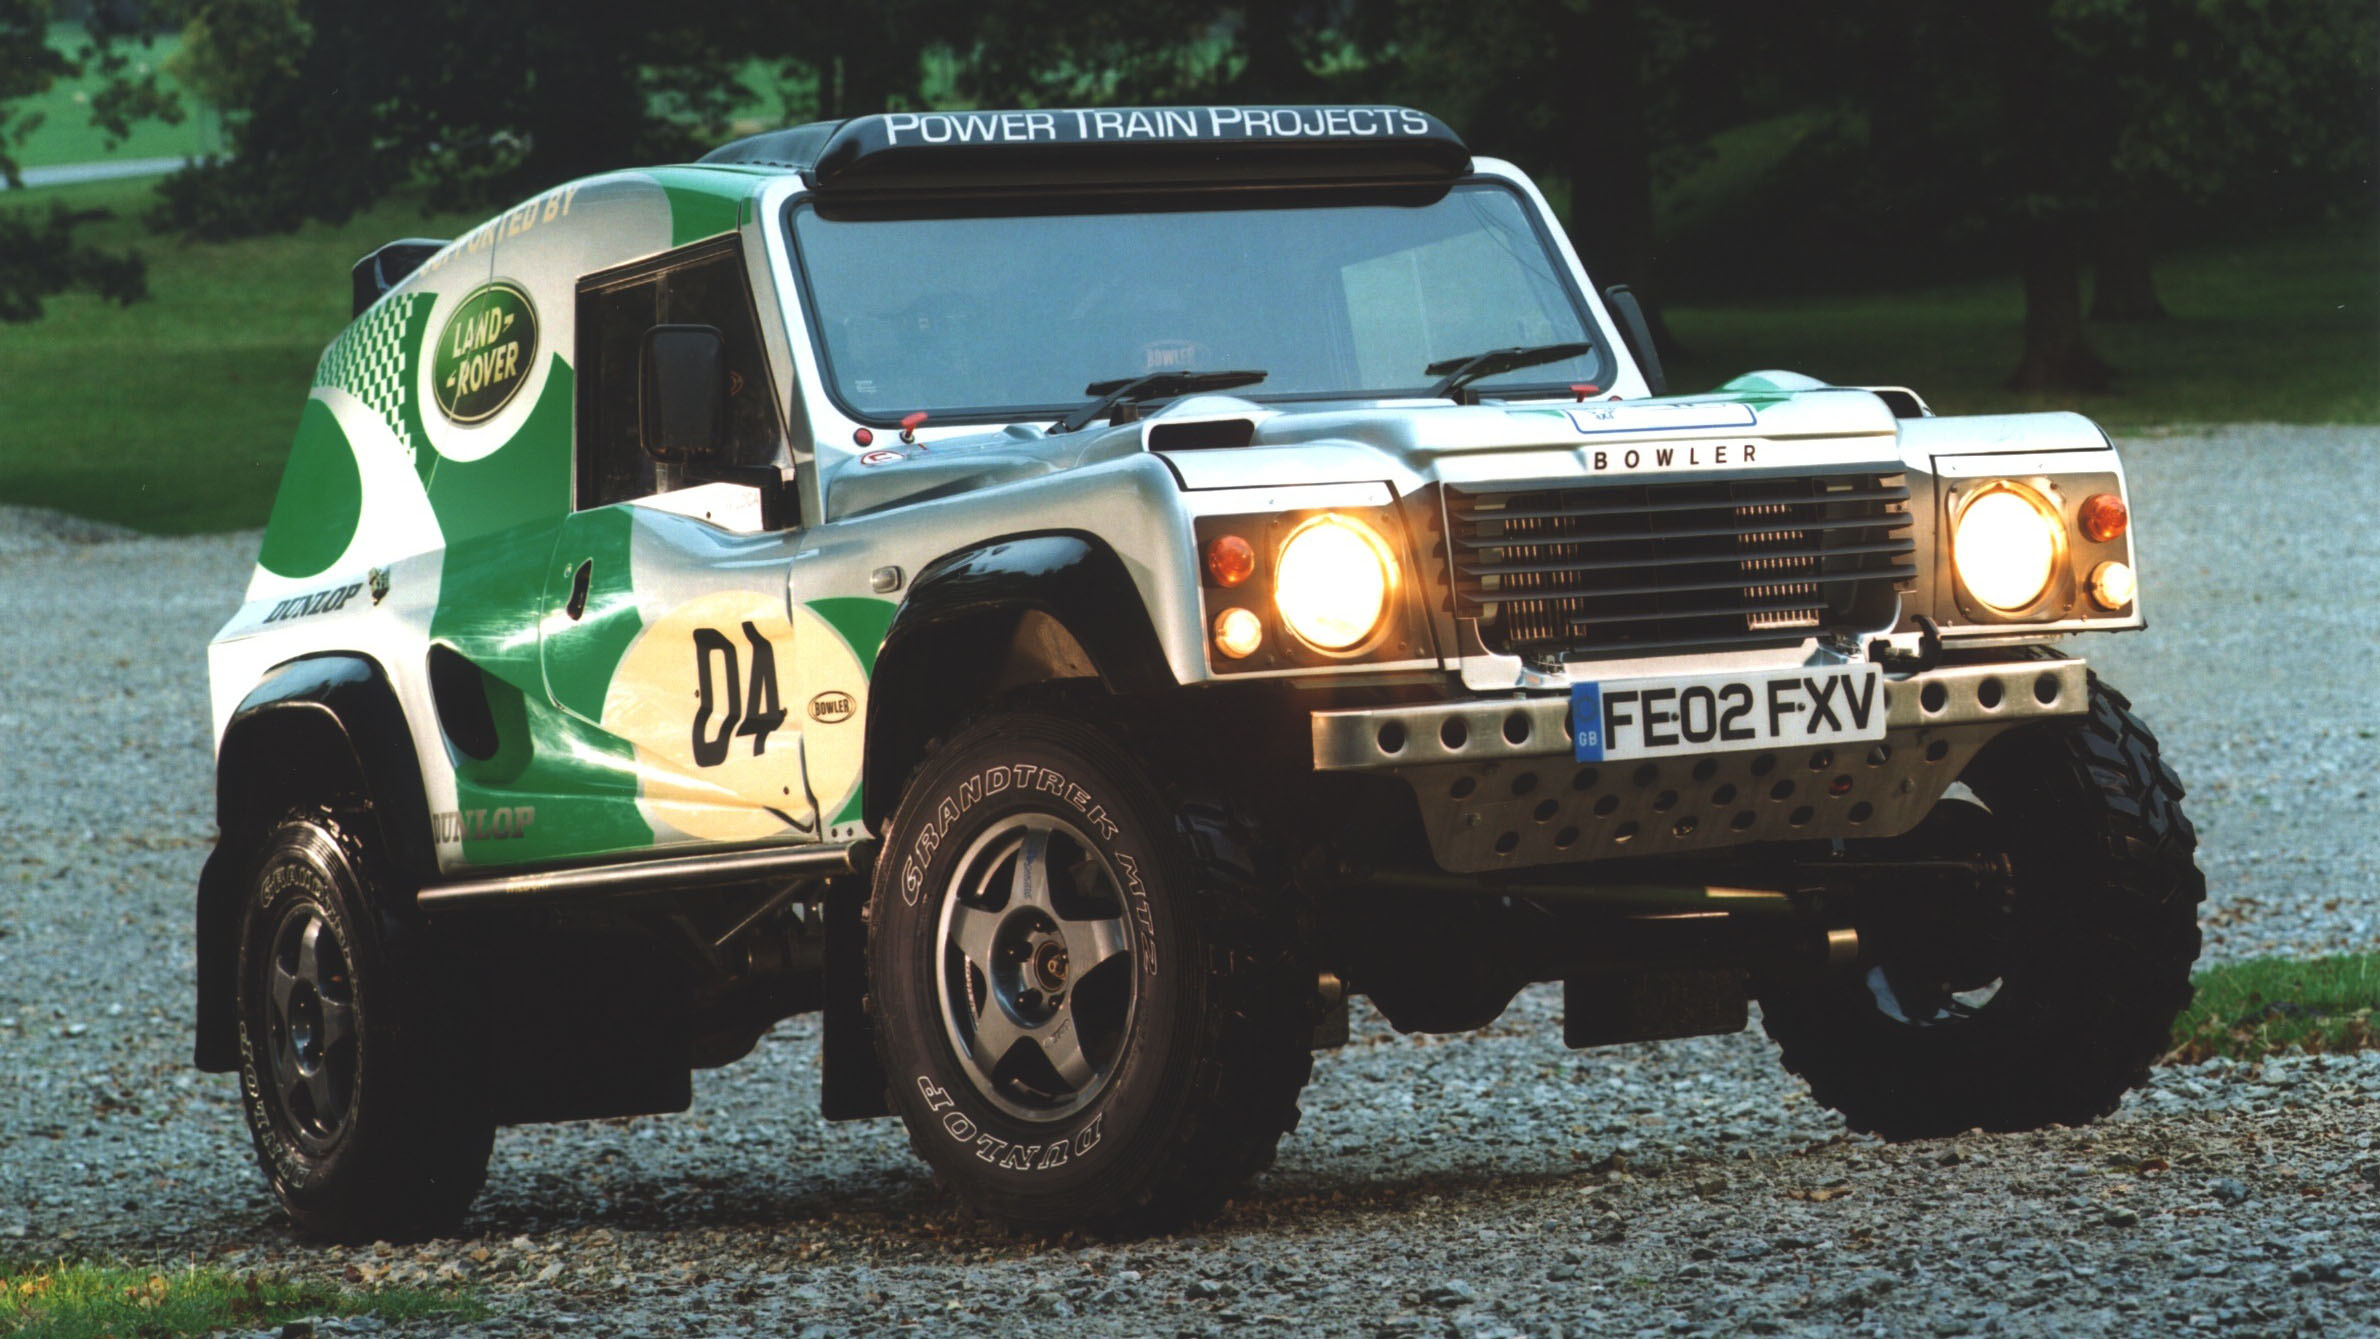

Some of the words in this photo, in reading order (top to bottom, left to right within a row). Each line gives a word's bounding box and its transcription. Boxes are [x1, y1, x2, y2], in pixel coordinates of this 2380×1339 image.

[884, 112, 1056, 145] POWER
[1075, 108, 1198, 140] TRAIN
[1207, 106, 1428, 137] PROJECTS
[1593, 444, 1757, 470] BOWLER
[262, 581, 364, 625] DUNLOP
[814, 698, 850, 717] BOWLER
[1602, 683, 1756, 750] FE02
[1766, 672, 1876, 737] FXV
[1579, 731, 1598, 747] GB
[432, 805, 535, 844] DUNLOP
[901, 763, 1119, 907] GRANDTREK
[916, 1074, 1103, 1171] DUNLOP
